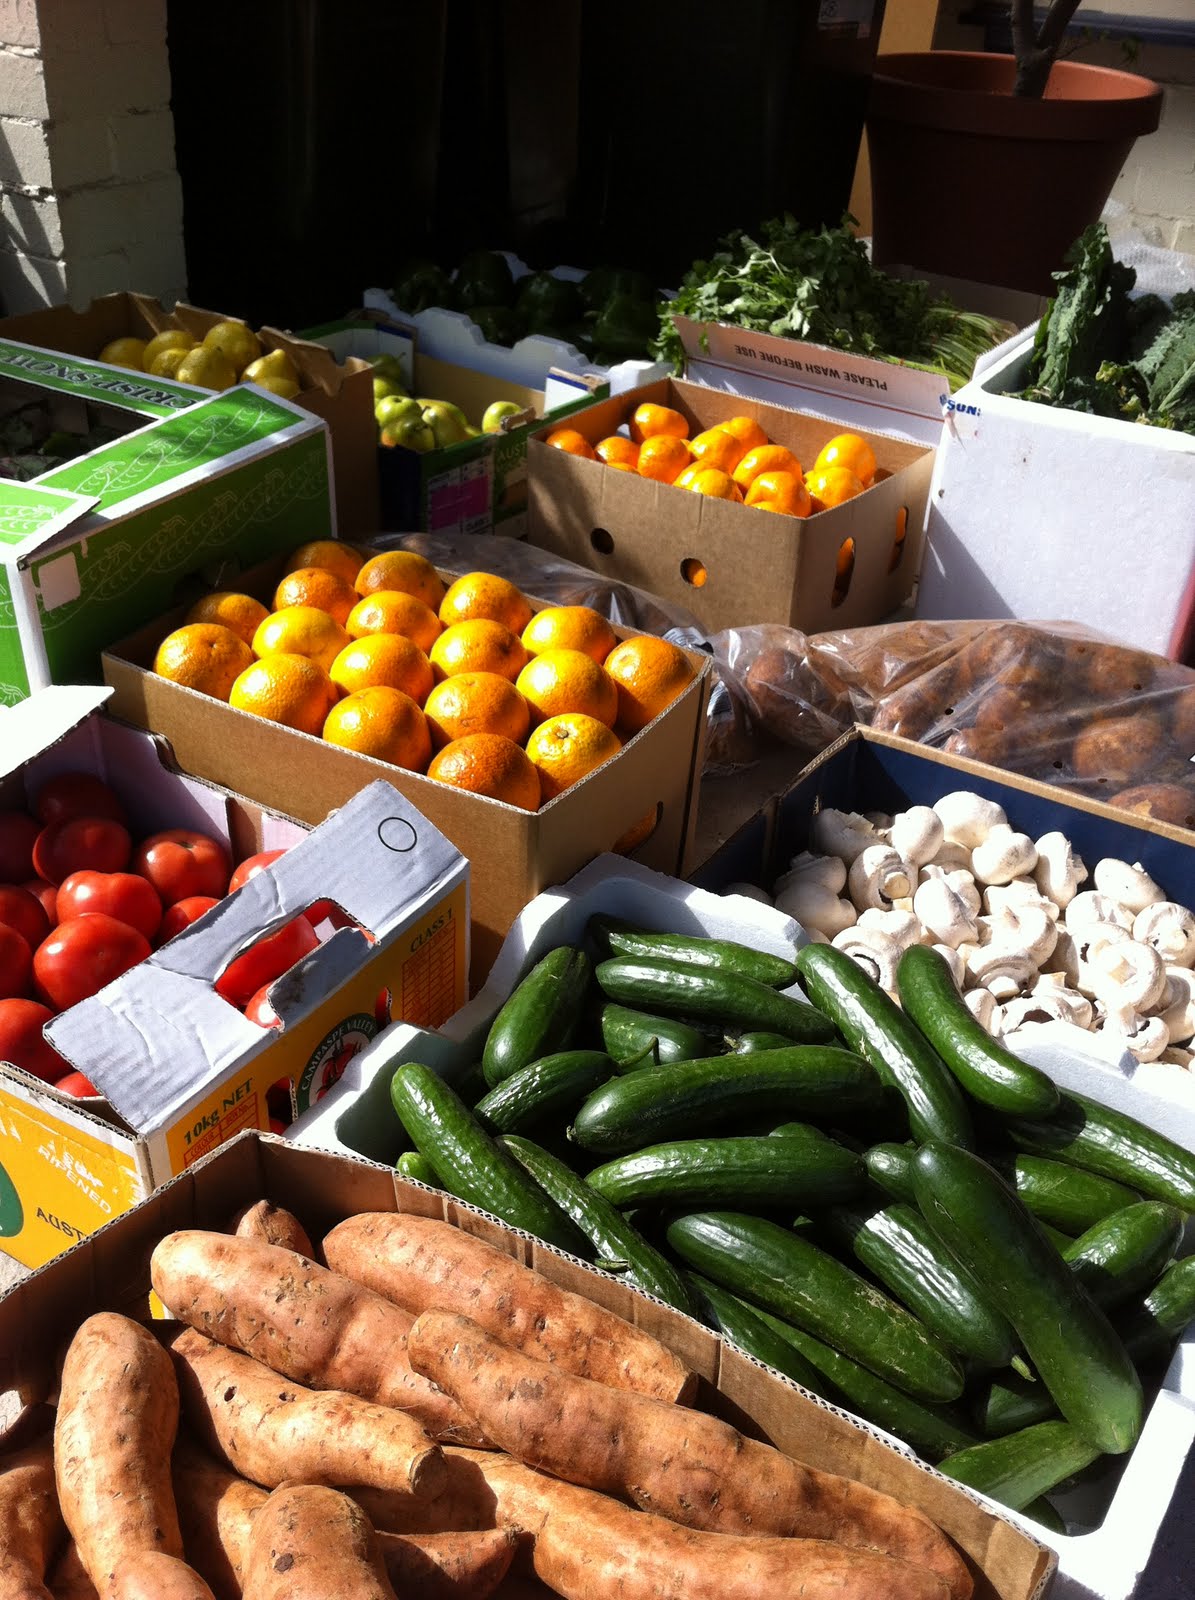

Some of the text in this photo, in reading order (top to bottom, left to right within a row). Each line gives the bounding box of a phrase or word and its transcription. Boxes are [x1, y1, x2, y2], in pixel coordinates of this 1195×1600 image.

[91, 380, 198, 411] CRISP
[734, 344, 888, 391] PLEASE WASH BEFORE USE
[410, 907, 454, 953] CLASS 1
[301, 1019, 374, 1091] CAMPASPE VALLEY
[184, 1077, 254, 1146] 10kg NET
[38, 1144, 112, 1214] RIPENED
